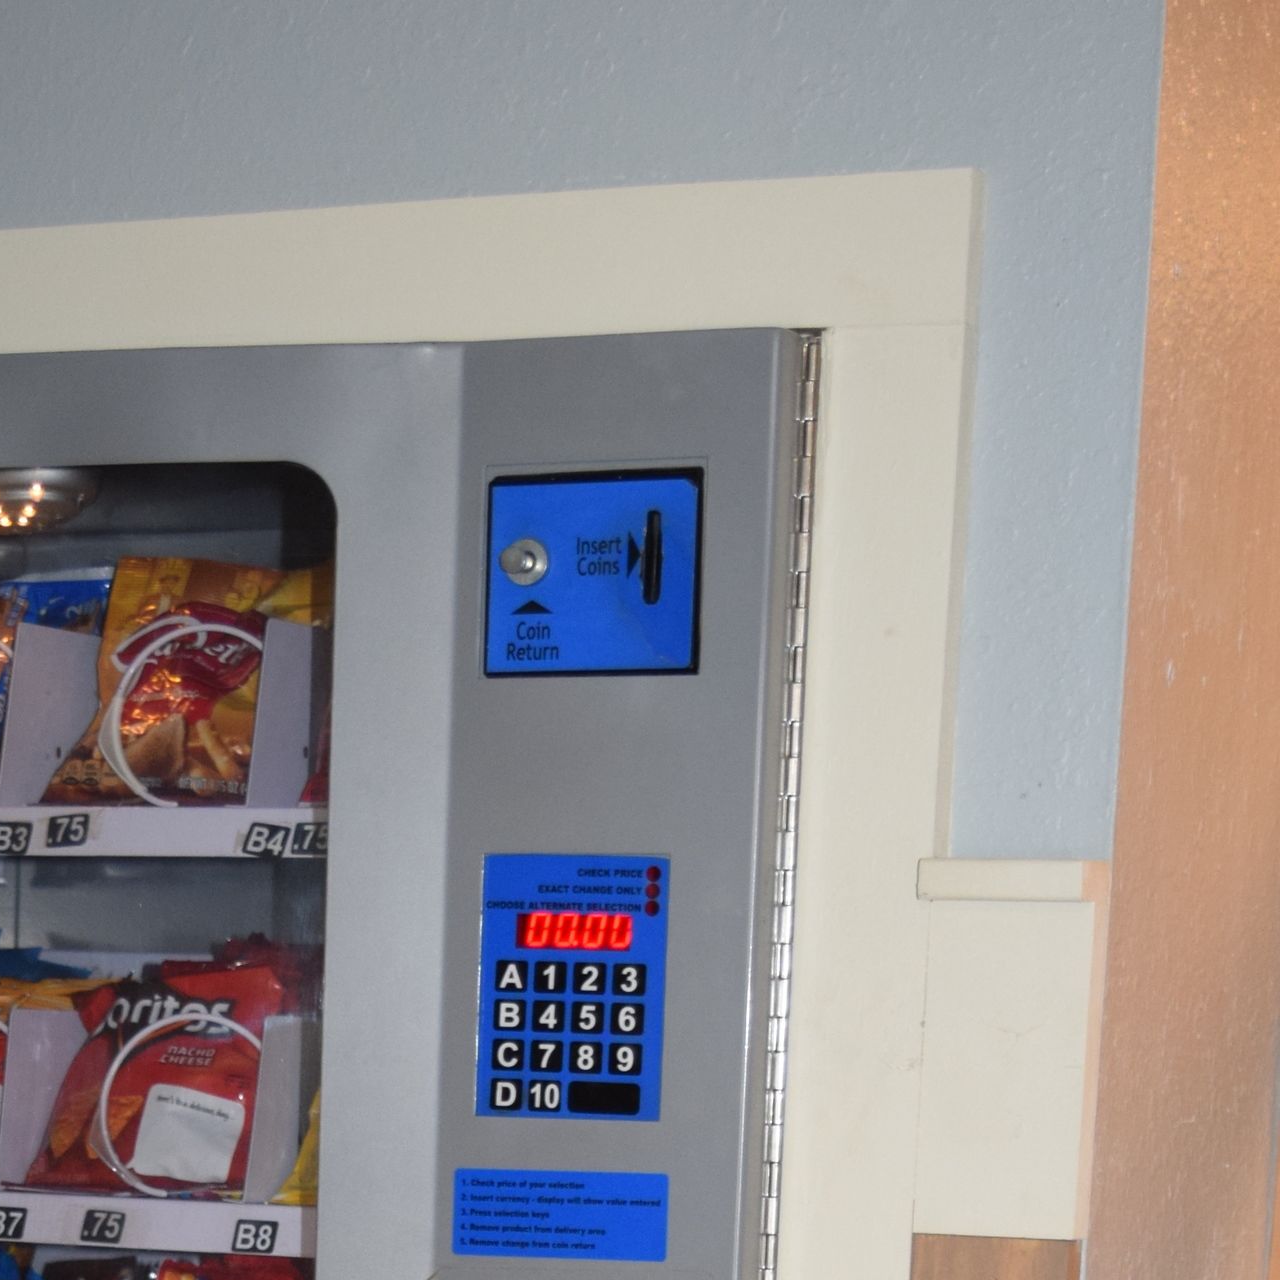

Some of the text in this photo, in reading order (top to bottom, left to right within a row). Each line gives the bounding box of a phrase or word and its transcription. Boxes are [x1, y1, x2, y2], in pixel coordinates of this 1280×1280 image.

[576, 536, 622, 555] Insert
[576, 557, 620, 577] Coins
[515, 620, 551, 640] Coin
[506, 641, 560, 662] Return
[47, 816, 86, 845] .75
[247, 826, 284, 855] B4
[577, 868, 644, 879] CHECK PRICE
[537, 884, 642, 897] EXACT CHANGE ONLY
[486, 900, 642, 914] CHOOSE ALTERNATE SELECTION
[499, 963, 524, 990] A
[542, 964, 556, 991] 1
[579, 966, 599, 992] 2
[620, 966, 639, 993] 3
[104, 993, 232, 1035] oritos
[498, 1002, 521, 1028] B
[538, 1003, 558, 1029] 4
[578, 1004, 597, 1030] 5
[617, 1006, 637, 1032] 6
[159, 1053, 214, 1067] CHEESE
[167, 1045, 216, 1058] NACHO
[496, 1042, 519, 1068] C
[537, 1043, 556, 1068] 7
[576, 1044, 595, 1070] 8
[615, 1046, 635, 1072] 9
[494, 1081, 518, 1107] D
[529, 1082, 561, 1109] 10
[471, 1178, 495, 1188] Check
[497, 1180, 517, 1190] price
[519, 1180, 528, 1189] of
[529, 1181, 547, 1191] your
[548, 1181, 586, 1190] selection
[470, 1194, 495, 1203] Insert
[496, 1195, 531, 1206] currency
[537, 1195, 566, 1207] display
[567, 1196, 582, 1205] will
[583, 1197, 605, 1206] show
[606, 1197, 628, 1207] value
[629, 1198, 662, 1208] entered
[470, 1208, 492, 1218] Press
[494, 1209, 530, 1219] selection
[531, 1210, 550, 1220] keys
[82, 1212, 120, 1239] .75
[235, 1222, 273, 1251] B8
[469, 1223, 500, 1233] Remove
[501, 1224, 533, 1235] product
[534, 1225, 553, 1234] from
[554, 1226, 586, 1237] delivery
[469, 1237, 500, 1247] Remove
[501, 1239, 530, 1250] change
[531, 1240, 551, 1249] from
[551, 1240, 570, 1249] coin
[571, 1241, 596, 1250] return
